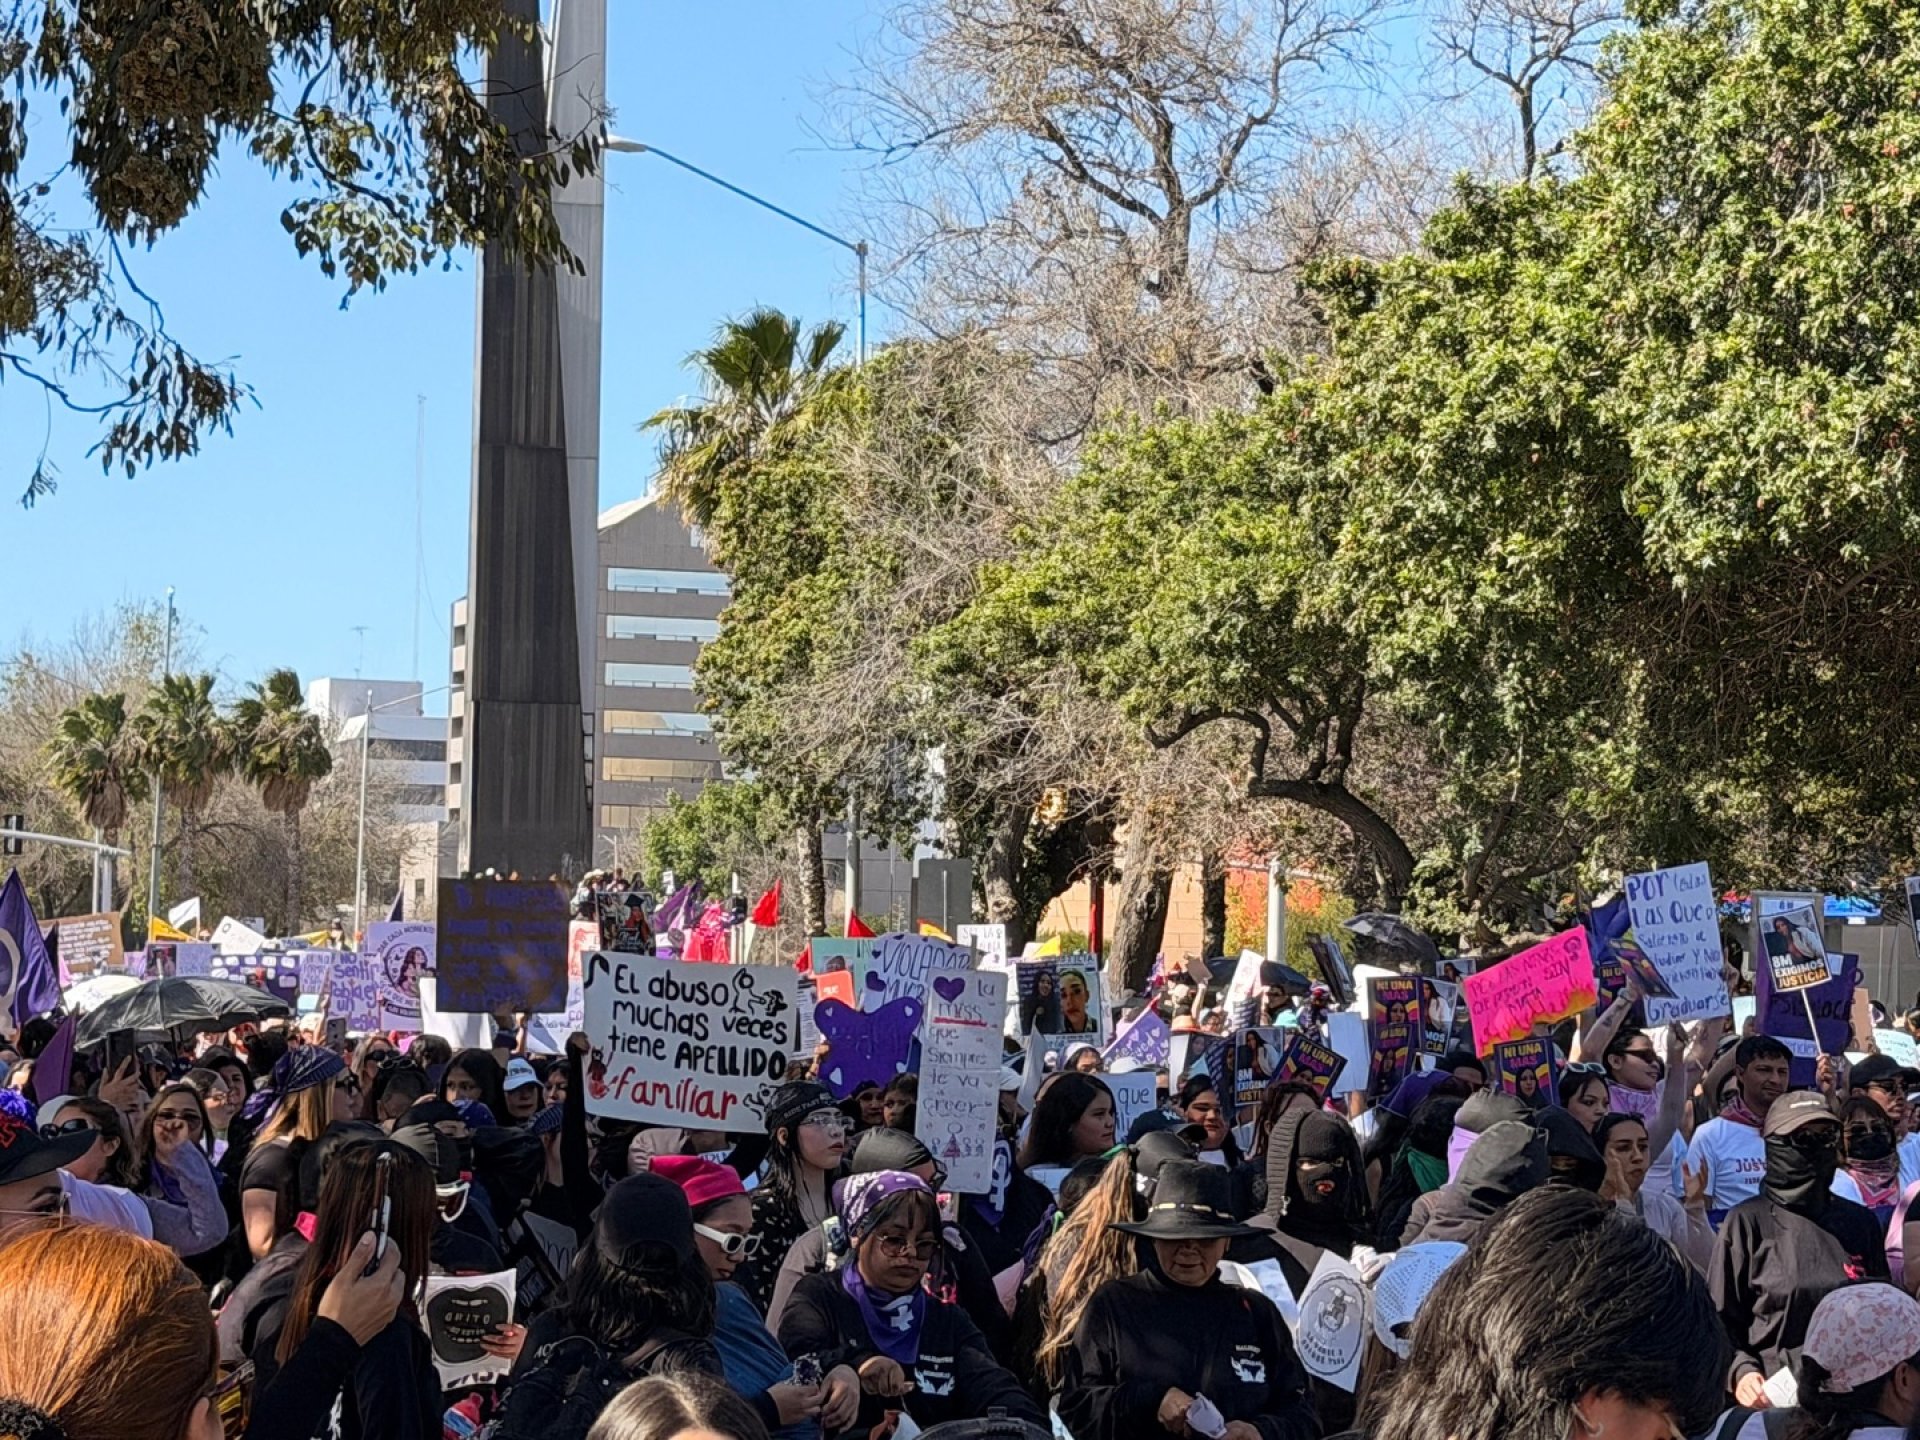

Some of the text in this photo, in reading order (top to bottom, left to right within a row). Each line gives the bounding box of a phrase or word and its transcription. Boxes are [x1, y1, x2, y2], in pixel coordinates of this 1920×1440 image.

[1774, 959, 1824, 977] EXIGIMOS
[1778, 968, 1827, 988] JUSTICIA
[648, 969, 729, 1006] abuso
[612, 1000, 710, 1041] muchas
[722, 1014, 788, 1045] veces
[608, 1025, 667, 1061] tiene
[674, 1041, 787, 1081] APELLIDO
[1518, 1042, 1543, 1056] UNA
[614, 1066, 738, 1121] familiar
[1118, 1087, 1150, 1116] que
